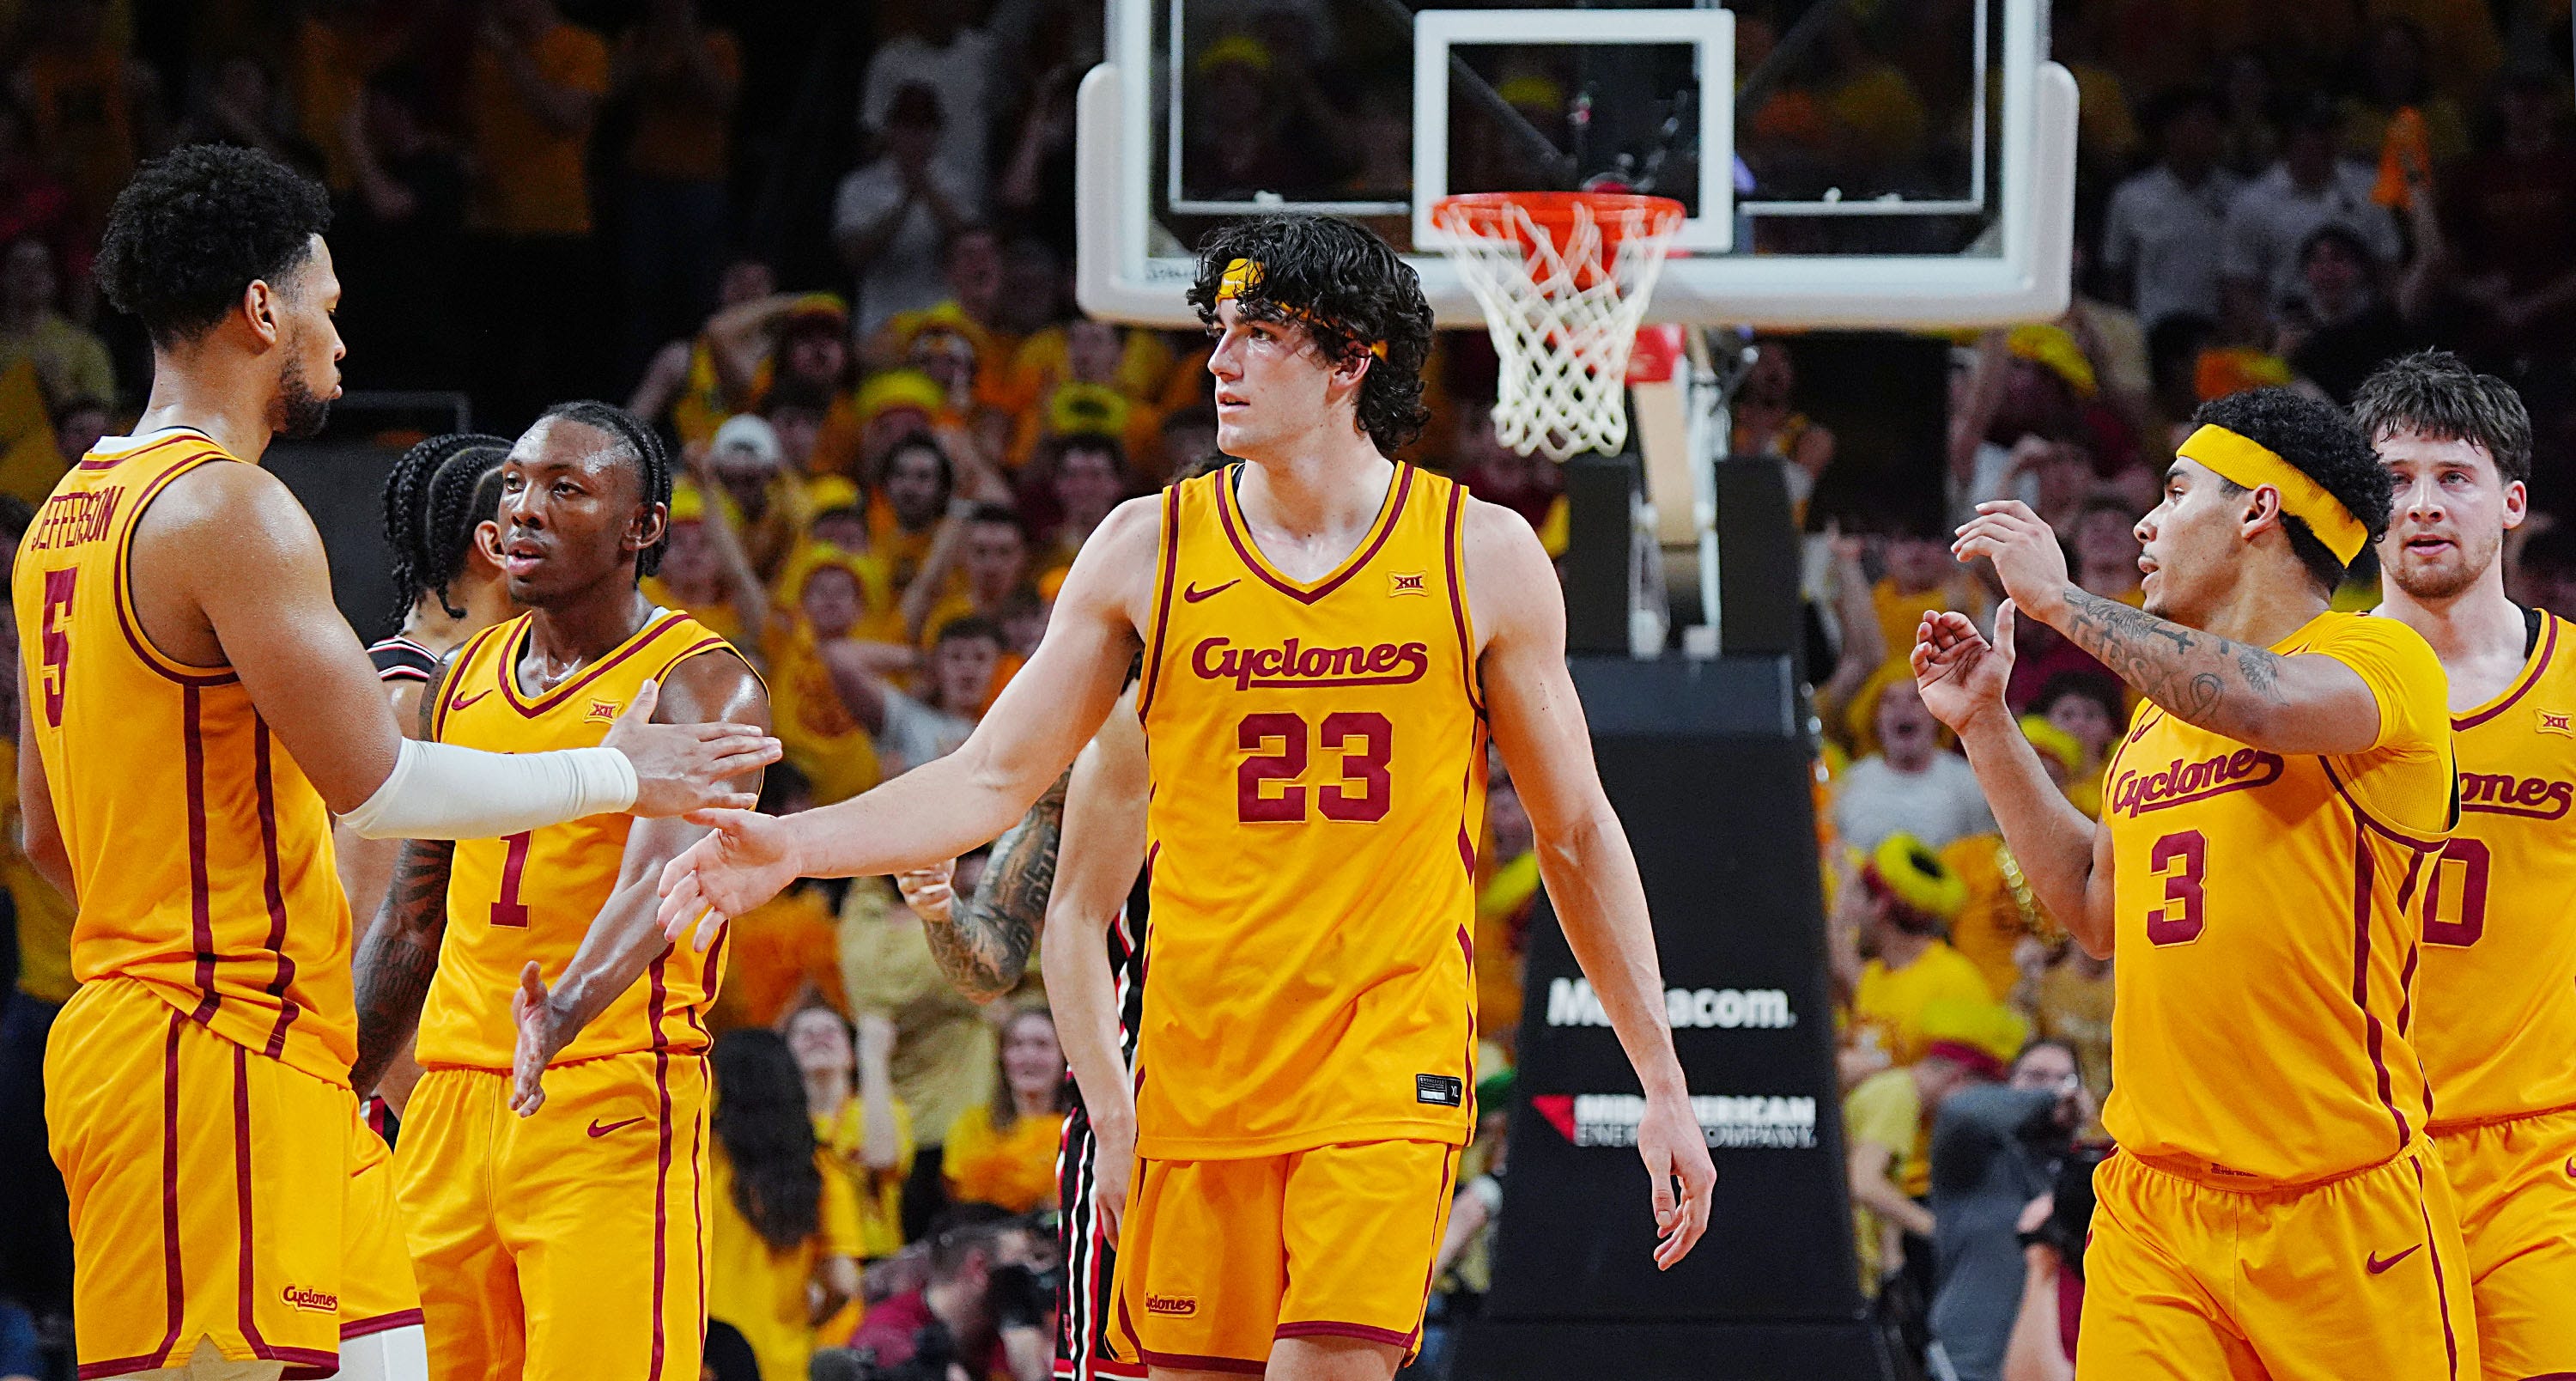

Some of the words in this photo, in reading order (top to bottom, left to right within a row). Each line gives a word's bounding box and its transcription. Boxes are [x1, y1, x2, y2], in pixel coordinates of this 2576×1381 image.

[31, 486, 125, 551] JEFFERSON
[1394, 575, 1423, 589] XII
[43, 567, 76, 728] 5
[1191, 637, 1429, 691] Cyclones
[1237, 712, 1393, 823] 23
[2113, 747, 2284, 818] Cyclones
[489, 830, 530, 928] 1
[2147, 830, 2208, 947] 3
[2421, 837, 2490, 947] 0
[1451, 1086, 1459, 1098] XL
[283, 1285, 338, 1311] Cyclones
